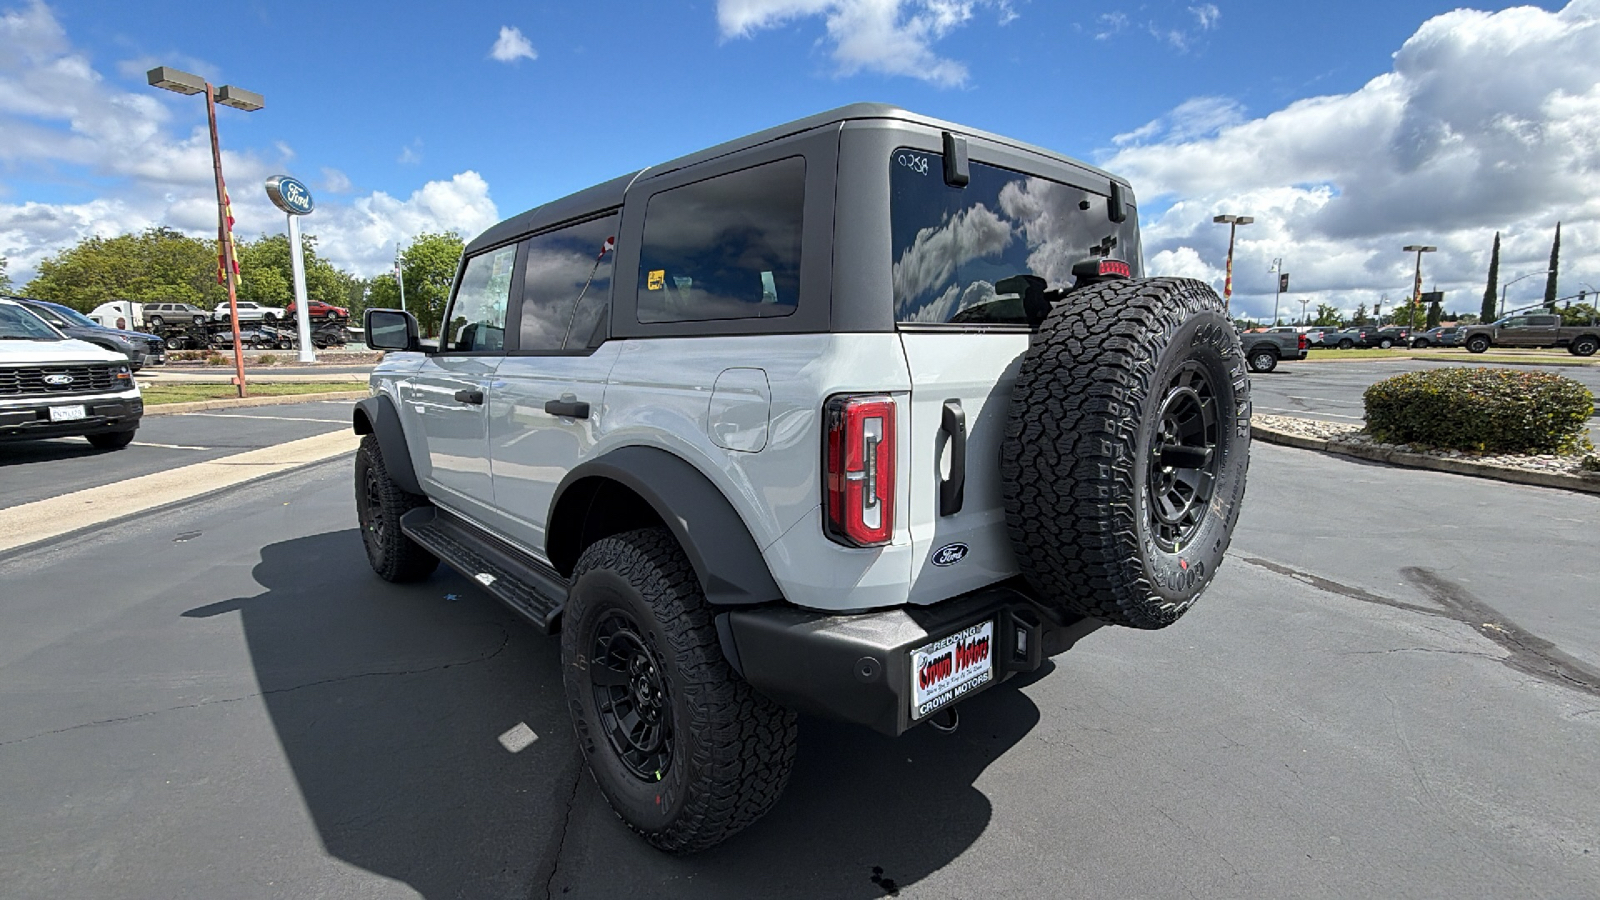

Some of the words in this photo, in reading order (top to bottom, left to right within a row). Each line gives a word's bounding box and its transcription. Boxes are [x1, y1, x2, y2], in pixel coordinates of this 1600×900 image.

[287, 183, 309, 208] Ford
[940, 547, 963, 563] Ford
[933, 627, 976, 651] REDDING
[919, 652, 952, 691] Crown
[955, 635, 989, 673] Motors
[920, 691, 952, 714] CROWN
[954, 673, 988, 697] MOTORS
